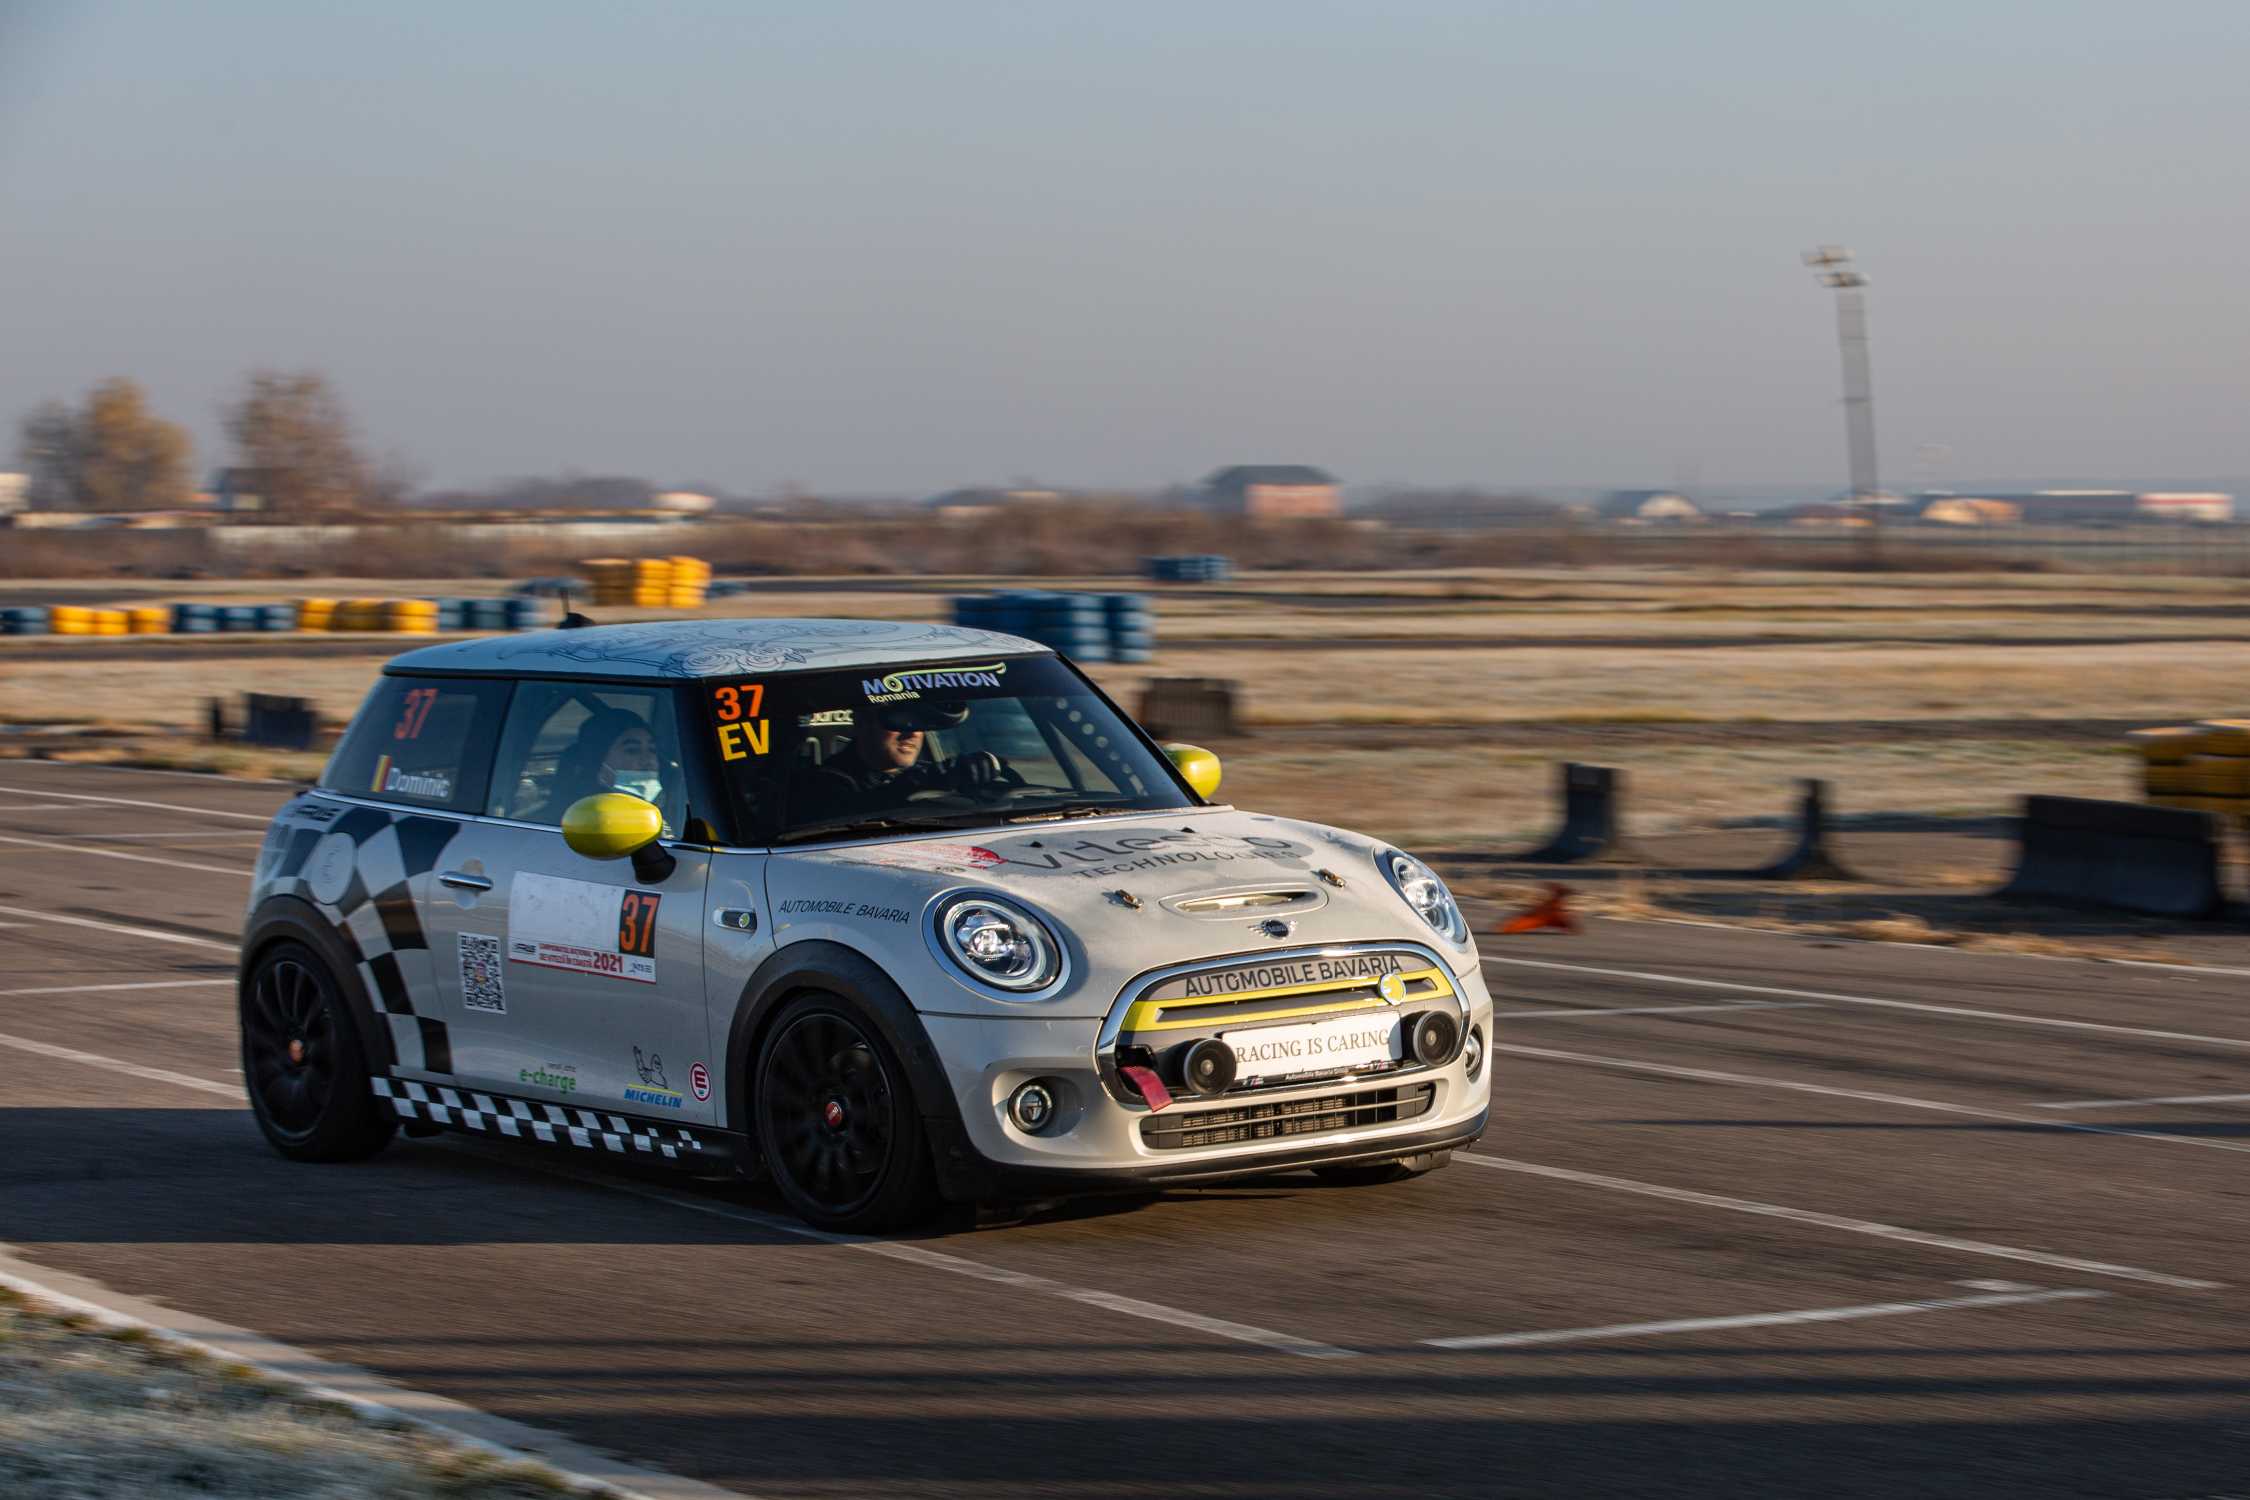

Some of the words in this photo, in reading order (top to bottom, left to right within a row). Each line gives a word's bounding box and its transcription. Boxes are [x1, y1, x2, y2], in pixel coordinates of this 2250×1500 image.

[862, 671, 1001, 695] MOTIVATION
[867, 689, 921, 704] Romania
[393, 688, 438, 739] 37
[715, 684, 764, 720] 37
[717, 719, 769, 761] EV
[1073, 849, 1302, 879] TECHNOLOGIES
[620, 894, 659, 953] 37
[779, 899, 855, 914] AUTOMOBILE
[856, 904, 911, 924] BAVARIA
[593, 951, 624, 973] 2021
[1185, 963, 1316, 997] AUTOMOBILE
[1318, 955, 1403, 982] BAVARIA
[1236, 1040, 1301, 1063] RACING
[1307, 1038, 1323, 1055] IS
[1327, 1029, 1389, 1052] CARING
[623, 1088, 683, 1109] MICHELIN
